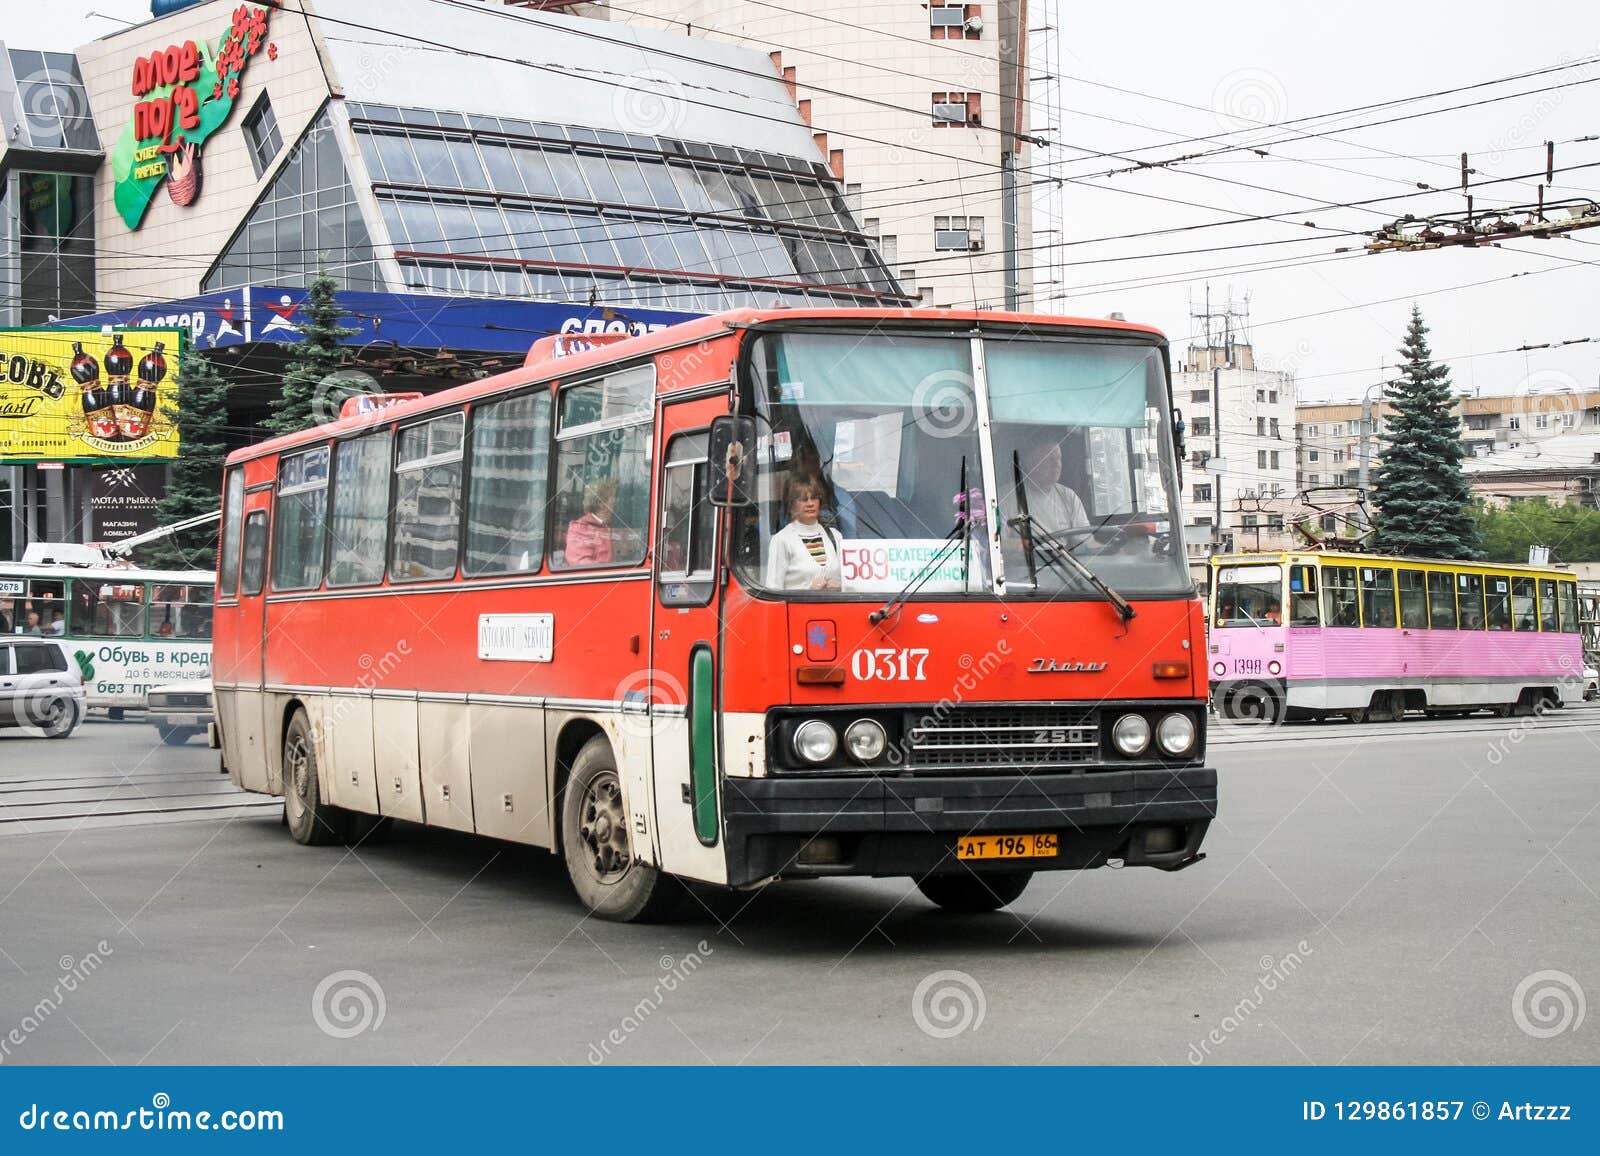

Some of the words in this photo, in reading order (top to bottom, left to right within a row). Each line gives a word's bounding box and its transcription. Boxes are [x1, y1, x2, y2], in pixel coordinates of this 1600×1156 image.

[91, 496, 124, 504] ЛОТАЯ
[126, 496, 158, 504] РЫБКА
[841, 547, 889, 580] 589
[1225, 570, 1233, 581] 6
[98, 646, 150, 667] Обувь
[155, 651, 165, 663] в
[170, 651, 213, 667] кред
[851, 648, 930, 681] 0317
[125, 670, 140, 679] до
[143, 668, 151, 679] 6
[1234, 658, 1262, 675] 1398
[97, 680, 124, 694] без
[995, 837, 1026, 856] 196
[1035, 836, 1052, 849] 66
